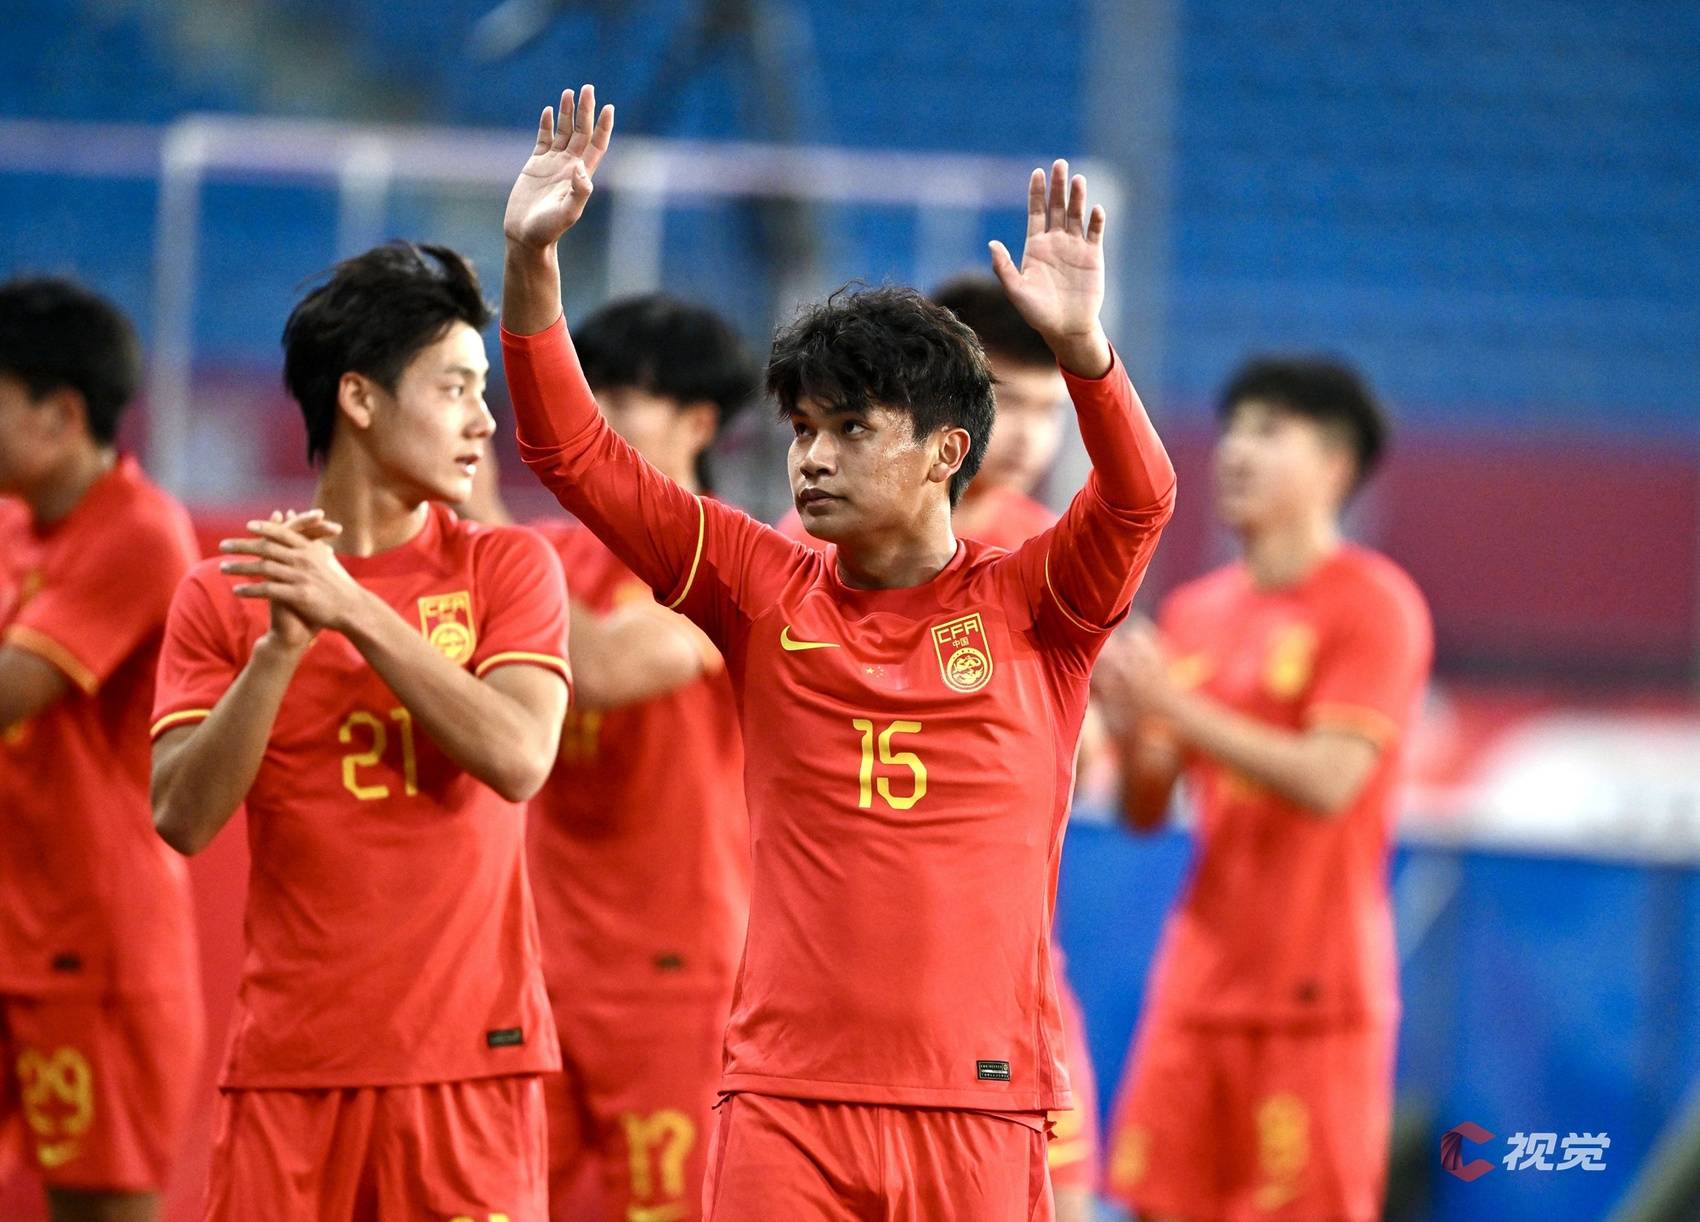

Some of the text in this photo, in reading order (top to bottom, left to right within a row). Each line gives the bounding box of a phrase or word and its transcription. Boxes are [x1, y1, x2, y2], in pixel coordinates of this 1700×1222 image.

[936, 619, 979, 644] CFA
[952, 636, 969, 648] 中国
[338, 706, 418, 801] 21
[852, 718, 928, 810] 15
[621, 1108, 695, 1197] 17
